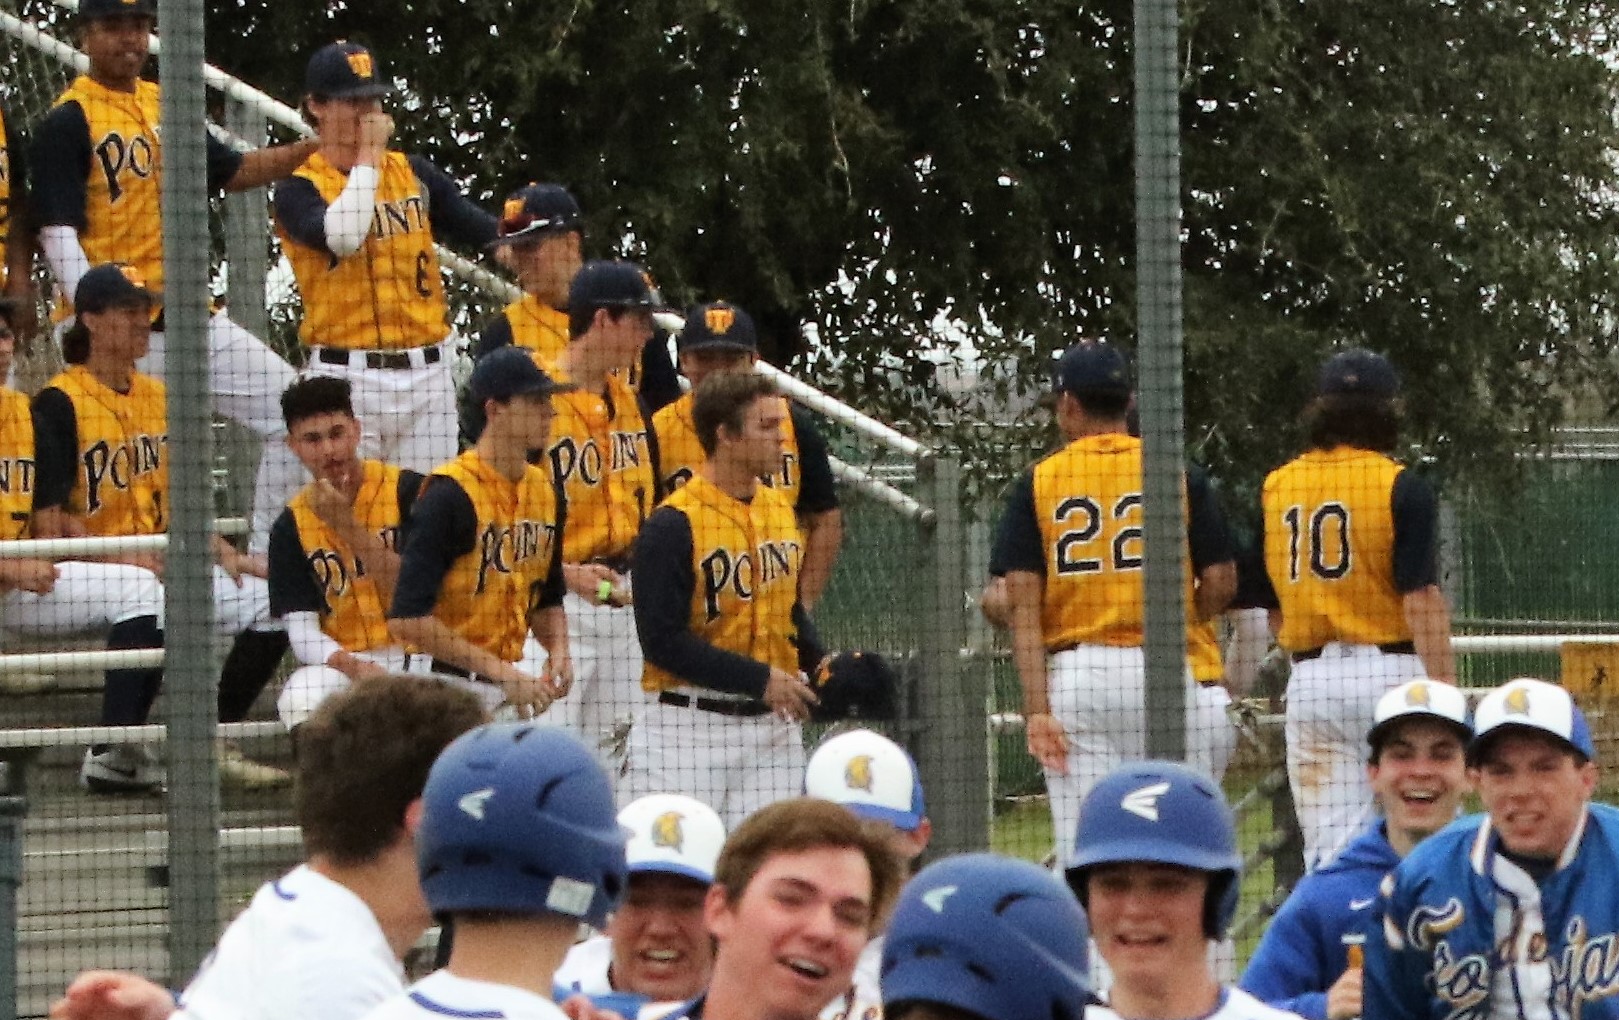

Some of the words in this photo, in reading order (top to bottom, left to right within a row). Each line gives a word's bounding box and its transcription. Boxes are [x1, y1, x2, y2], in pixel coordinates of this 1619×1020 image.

[372, 195, 422, 241] INT
[82, 434, 168, 517] POIN
[548, 431, 647, 514] POIN
[1283, 501, 1352, 583] 10
